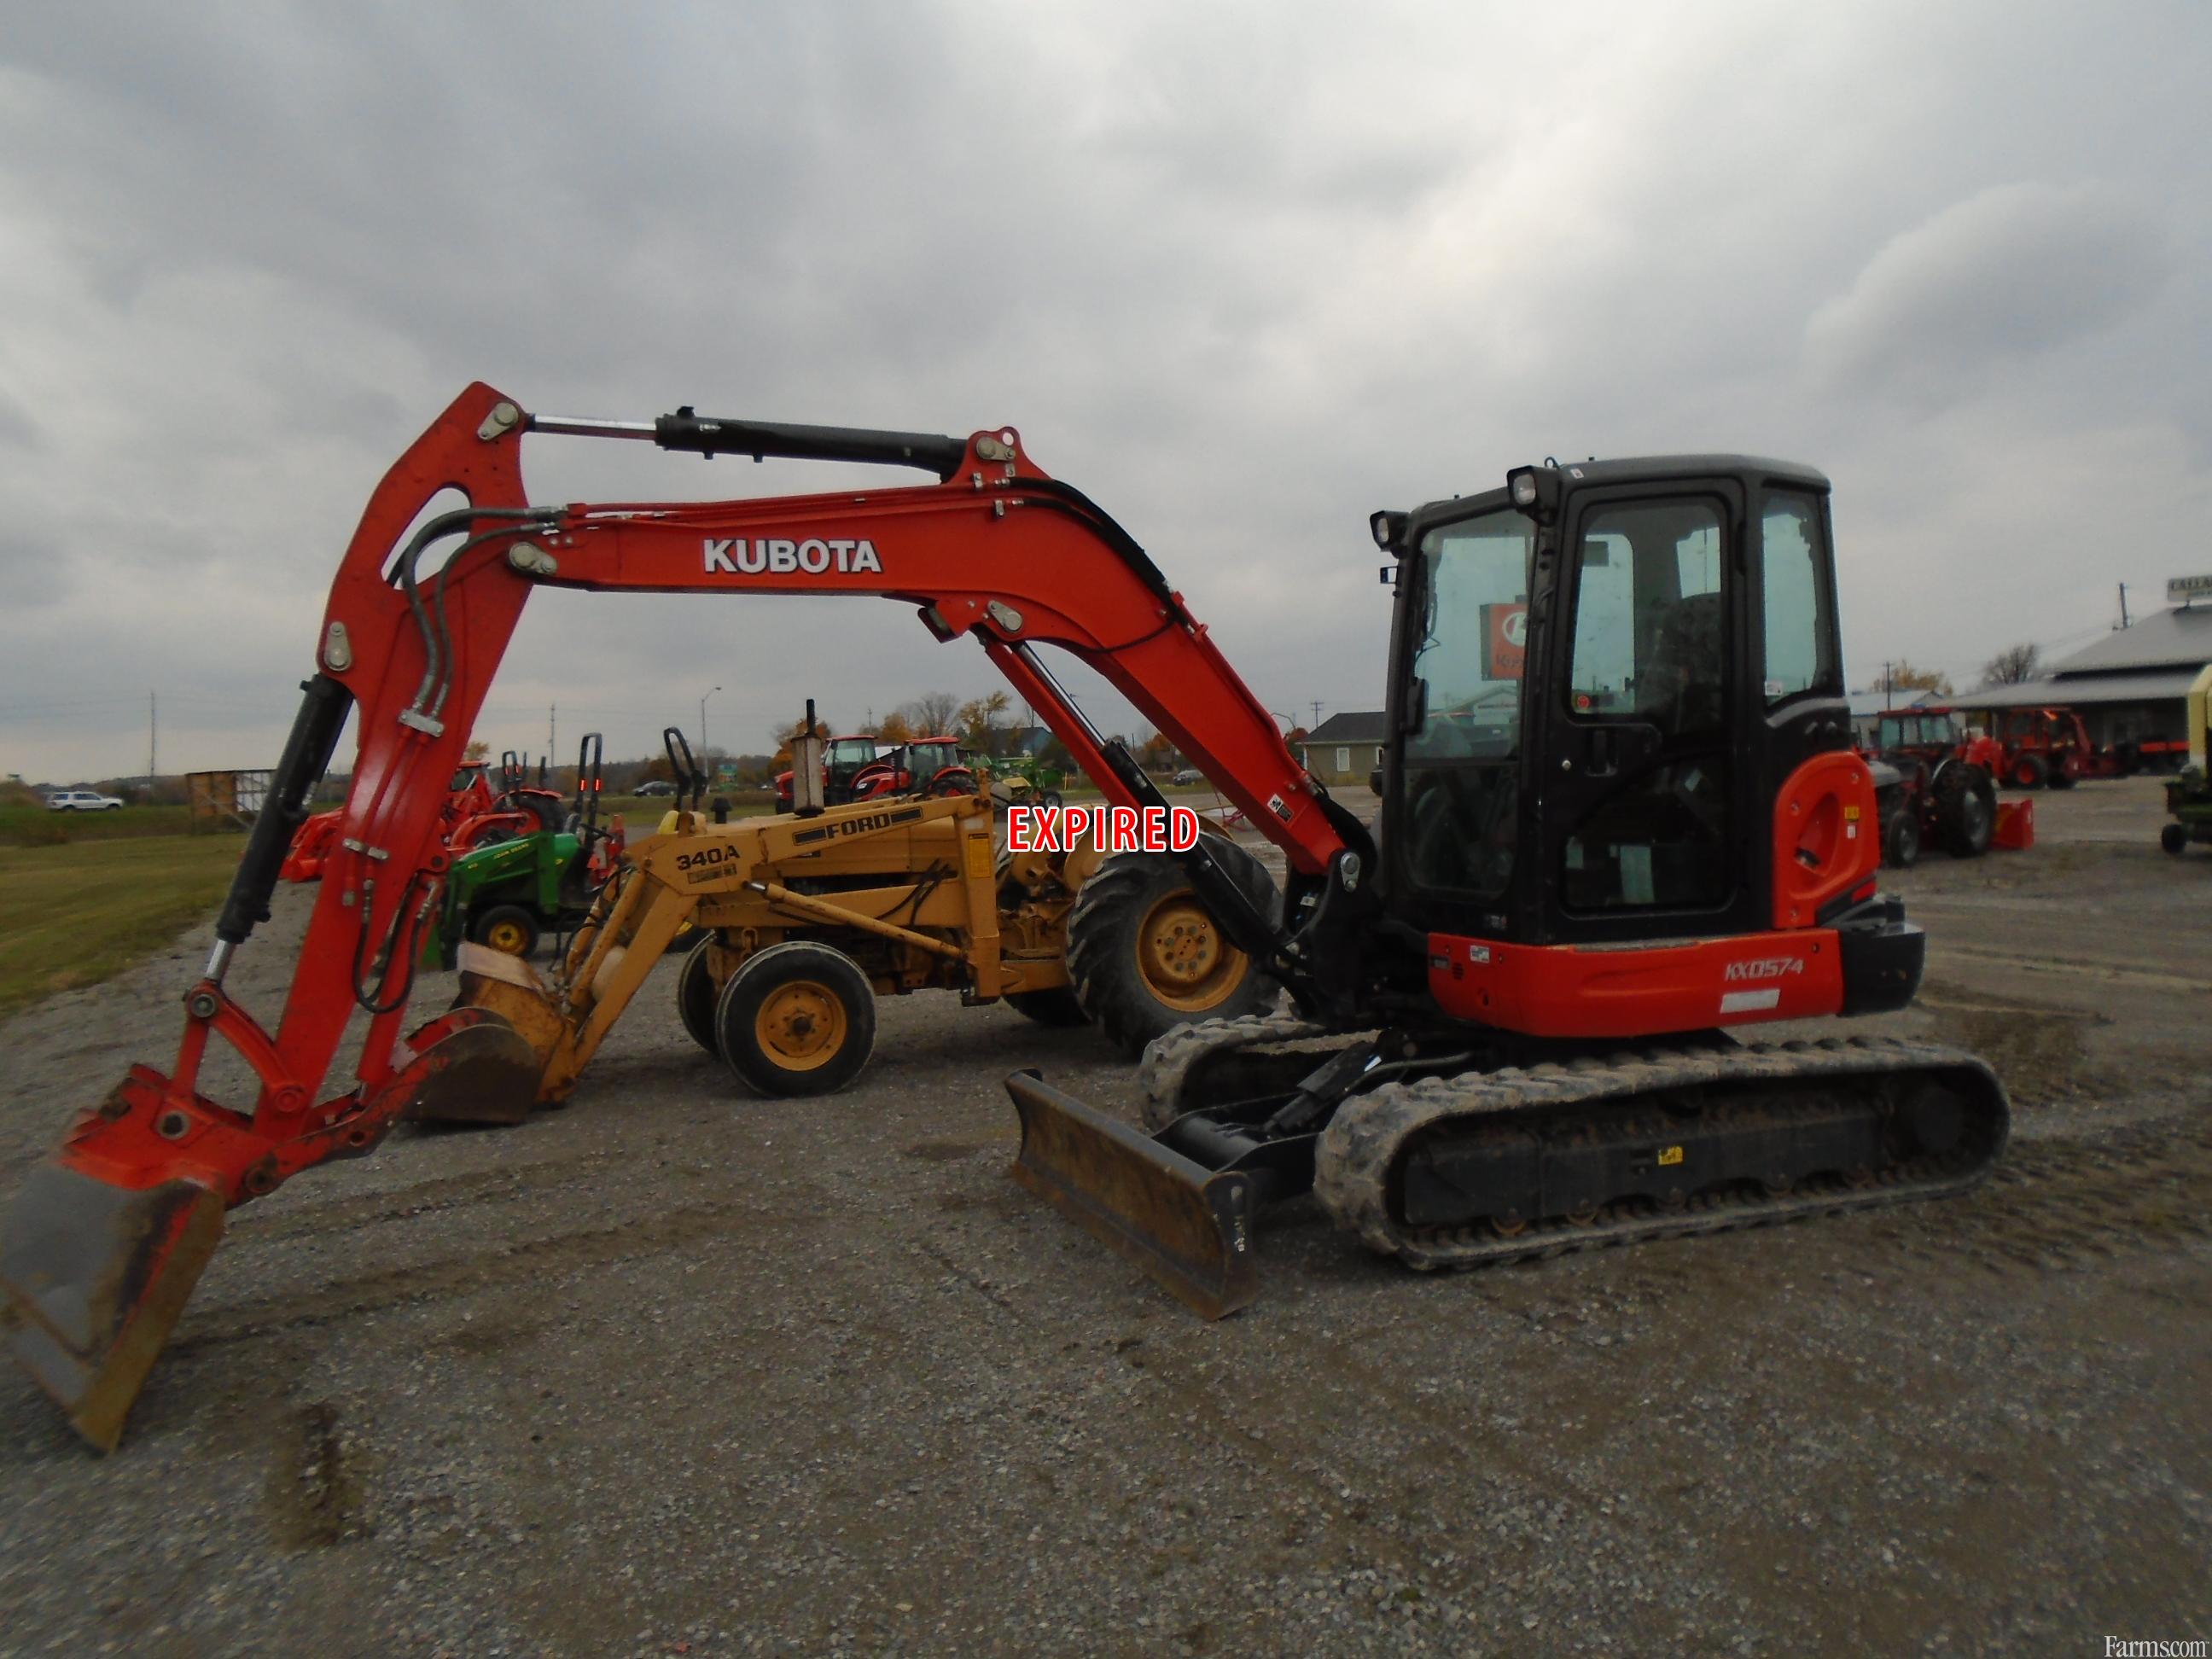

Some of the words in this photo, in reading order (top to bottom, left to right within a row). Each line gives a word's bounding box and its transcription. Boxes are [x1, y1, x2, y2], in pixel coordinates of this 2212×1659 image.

[702, 538, 882, 573] KUBOTA
[826, 812, 890, 839] FORD
[676, 845, 741, 870] 340A
